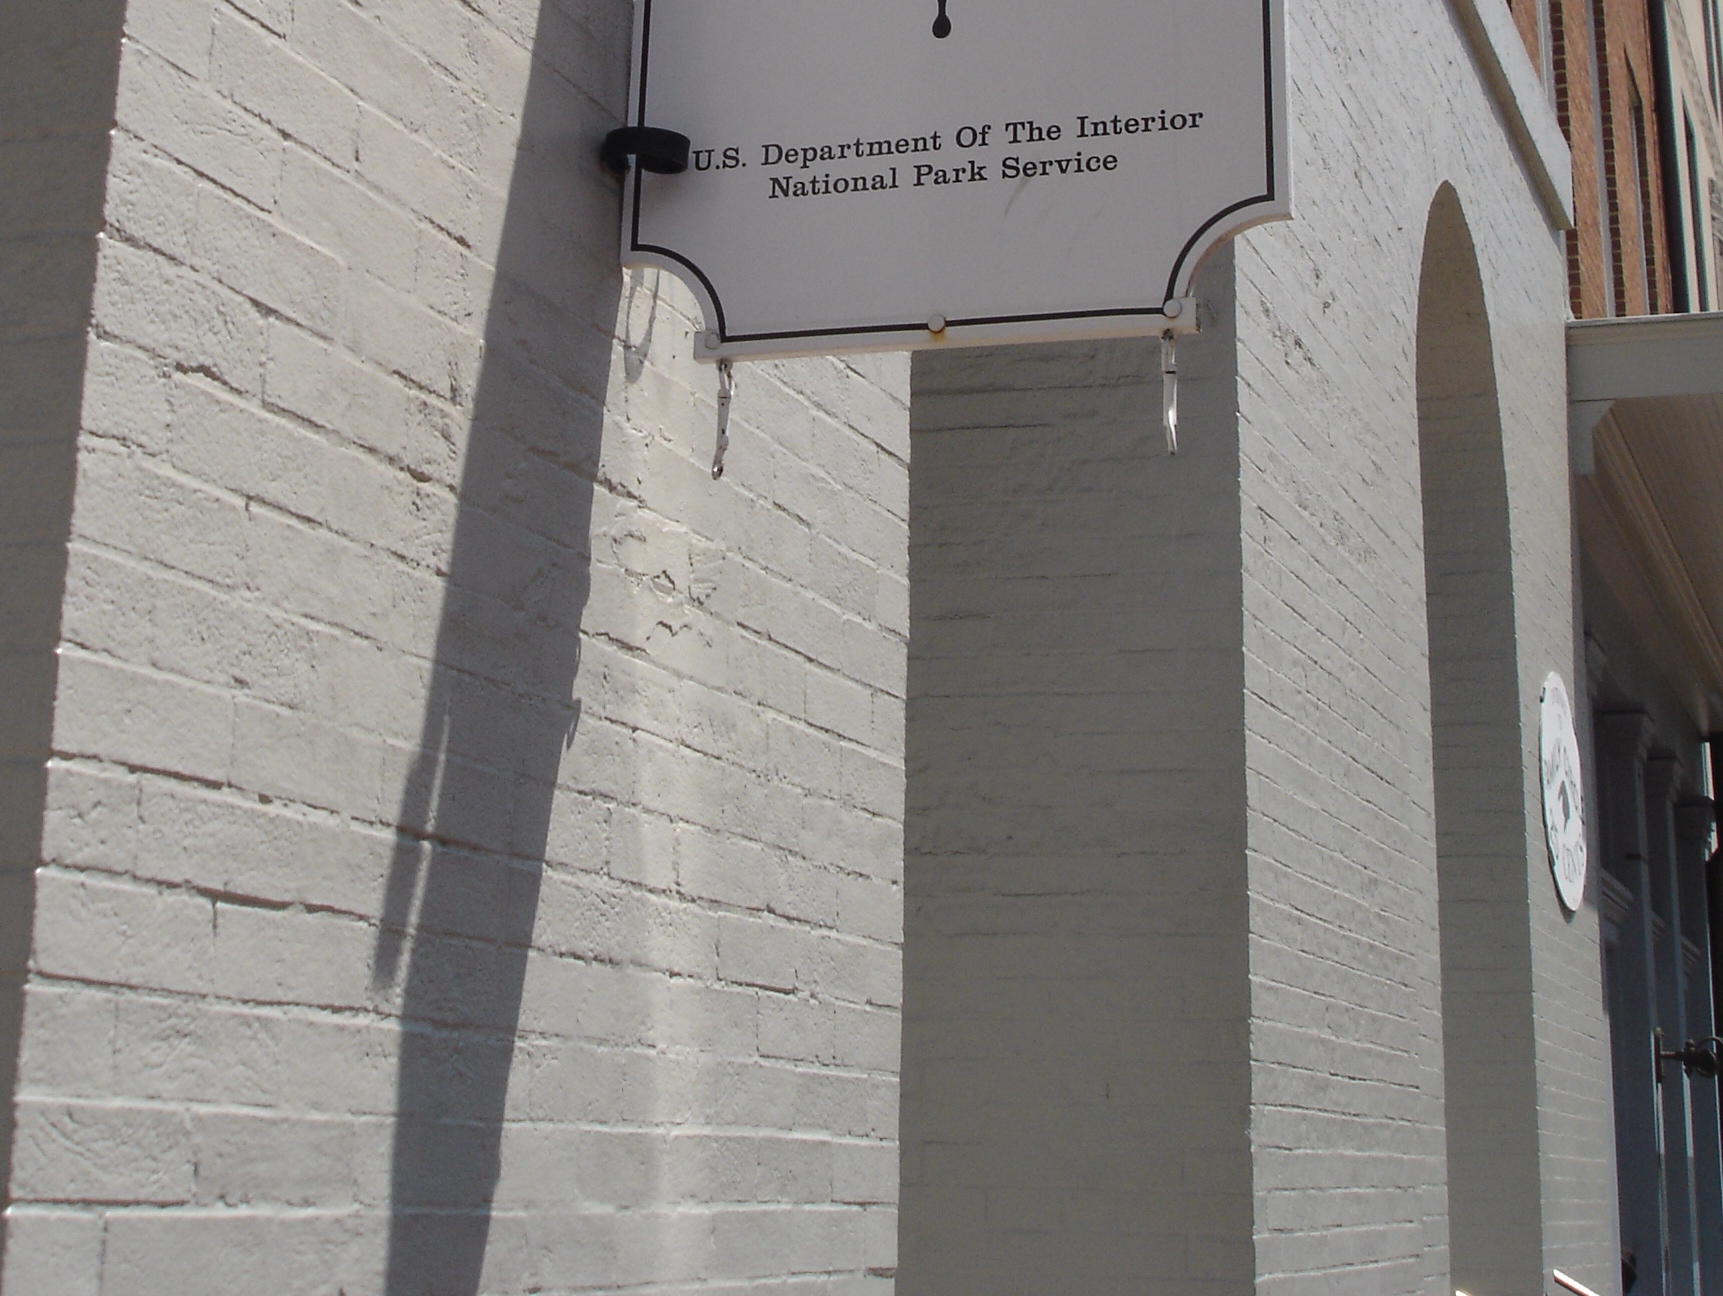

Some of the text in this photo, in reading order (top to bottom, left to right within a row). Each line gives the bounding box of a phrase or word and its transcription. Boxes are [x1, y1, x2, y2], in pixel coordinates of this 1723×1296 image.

[692, 109, 1205, 172] U.S. Department Of The Interior
[768, 151, 1118, 199] National Park Service
